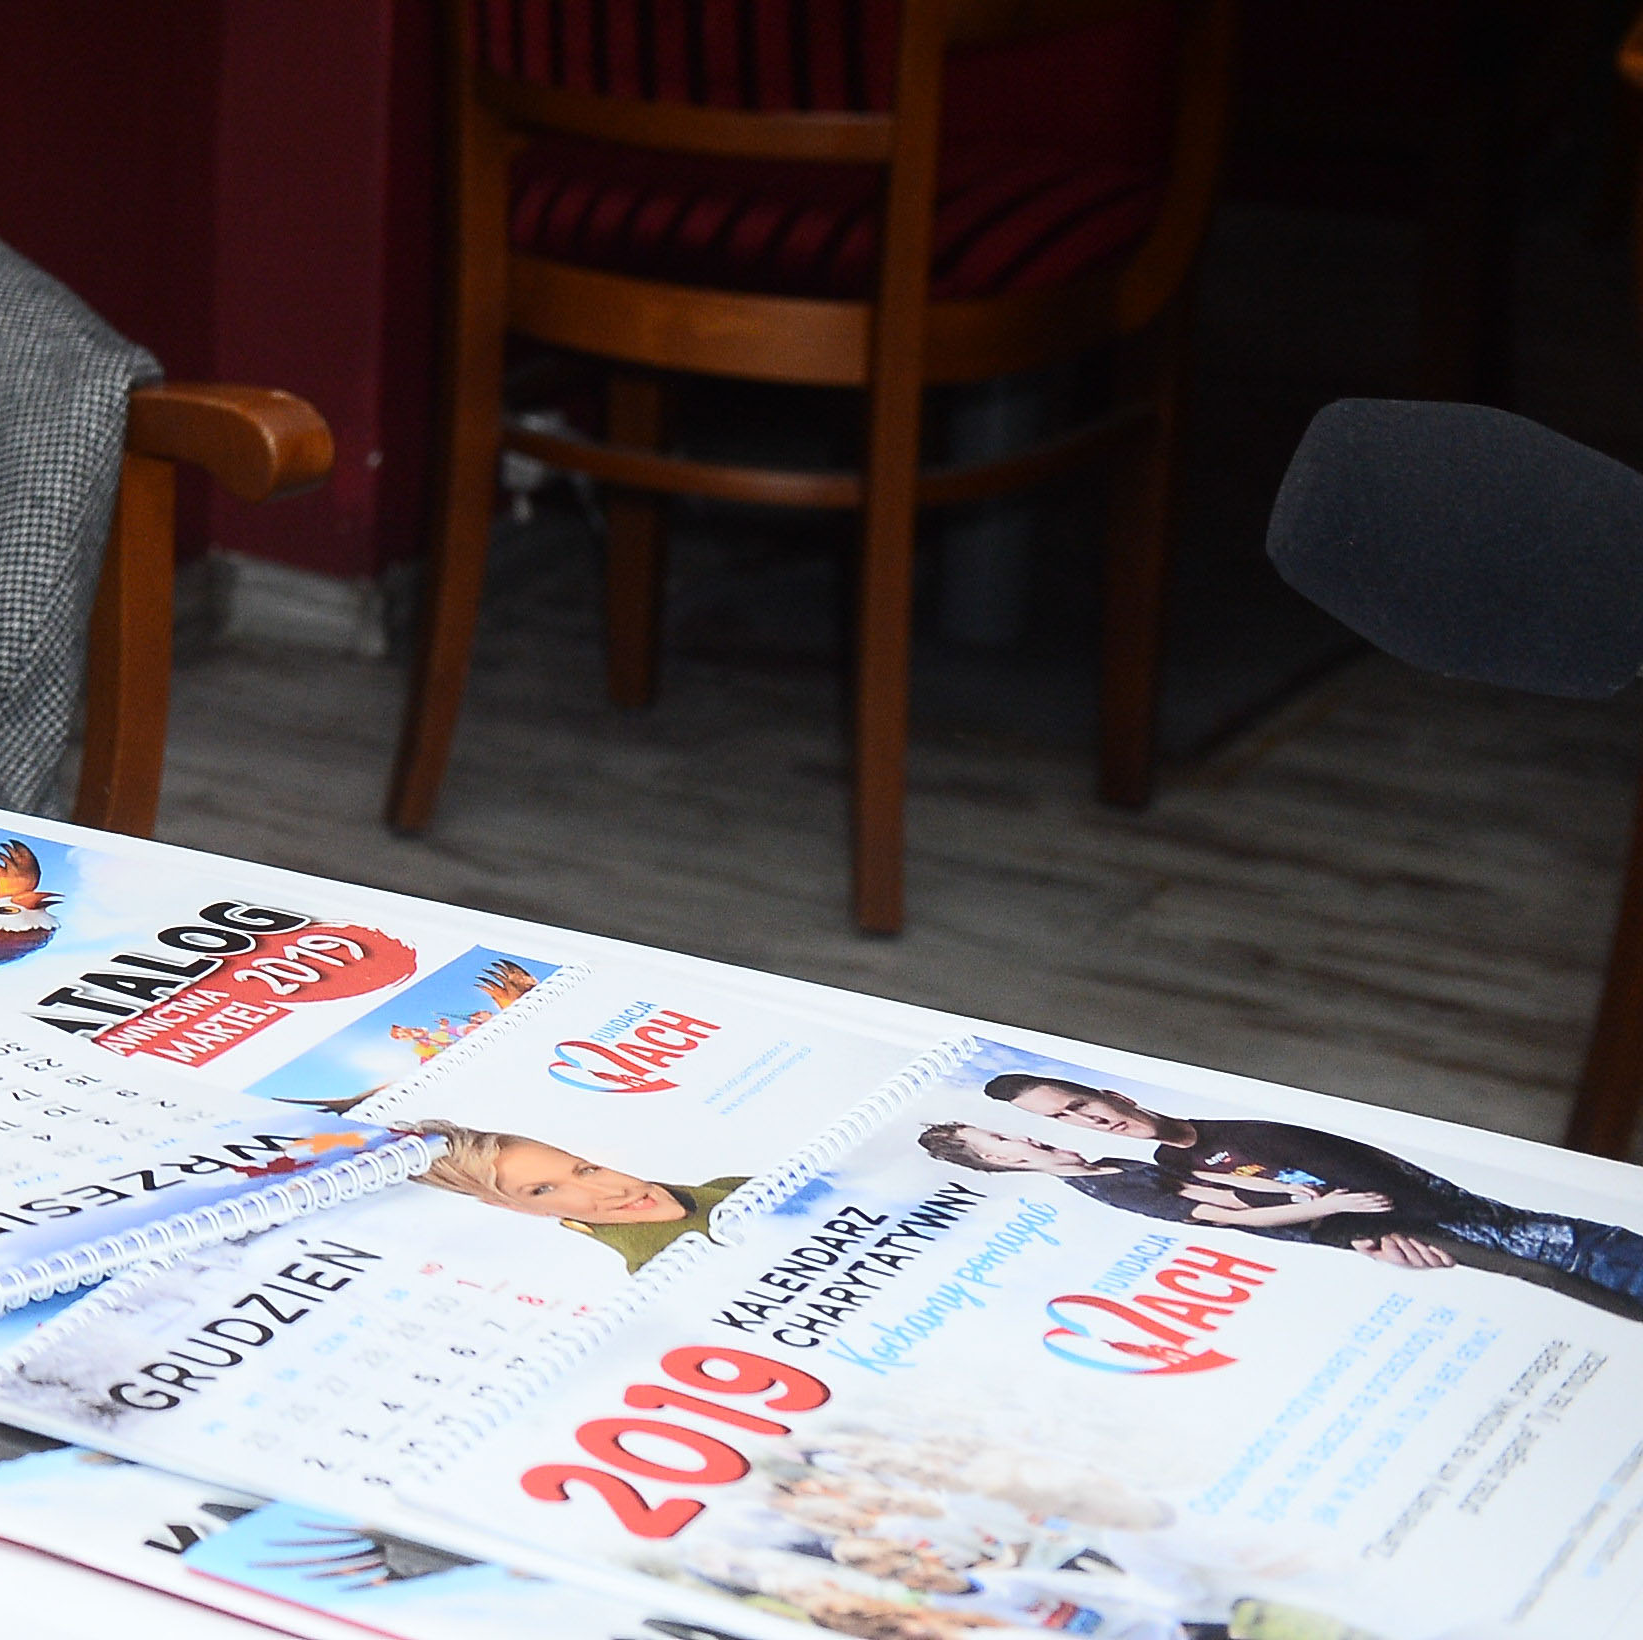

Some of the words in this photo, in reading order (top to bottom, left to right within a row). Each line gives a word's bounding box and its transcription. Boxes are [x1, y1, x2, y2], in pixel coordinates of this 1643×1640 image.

[30, 901, 315, 1041] ATALOG
[233, 933, 365, 996] 2019
[99, 987, 231, 1056] AWNICTWA
[153, 999, 279, 1063] MARTEL
[589, 1000, 659, 1044] FUNDACJA
[12, 1089, 41, 1102] 17
[23, 1058, 63, 1072] 23
[65, 1075, 101, 1086] 16
[116, 1090, 139, 1098] 9
[43, 1105, 81, 1117] 10
[711, 1205, 890, 1333] KALENDARZ
[772, 1180, 988, 1349] CHARYTATYWNY
[827, 1281, 987, 1376] Kochamy
[955, 1196, 1061, 1289] pomagać
[1091, 1233, 1180, 1297] FUNDACJA
[108, 1237, 383, 1412] GRUDZIEŃ
[520, 1345, 832, 1540] 2019
